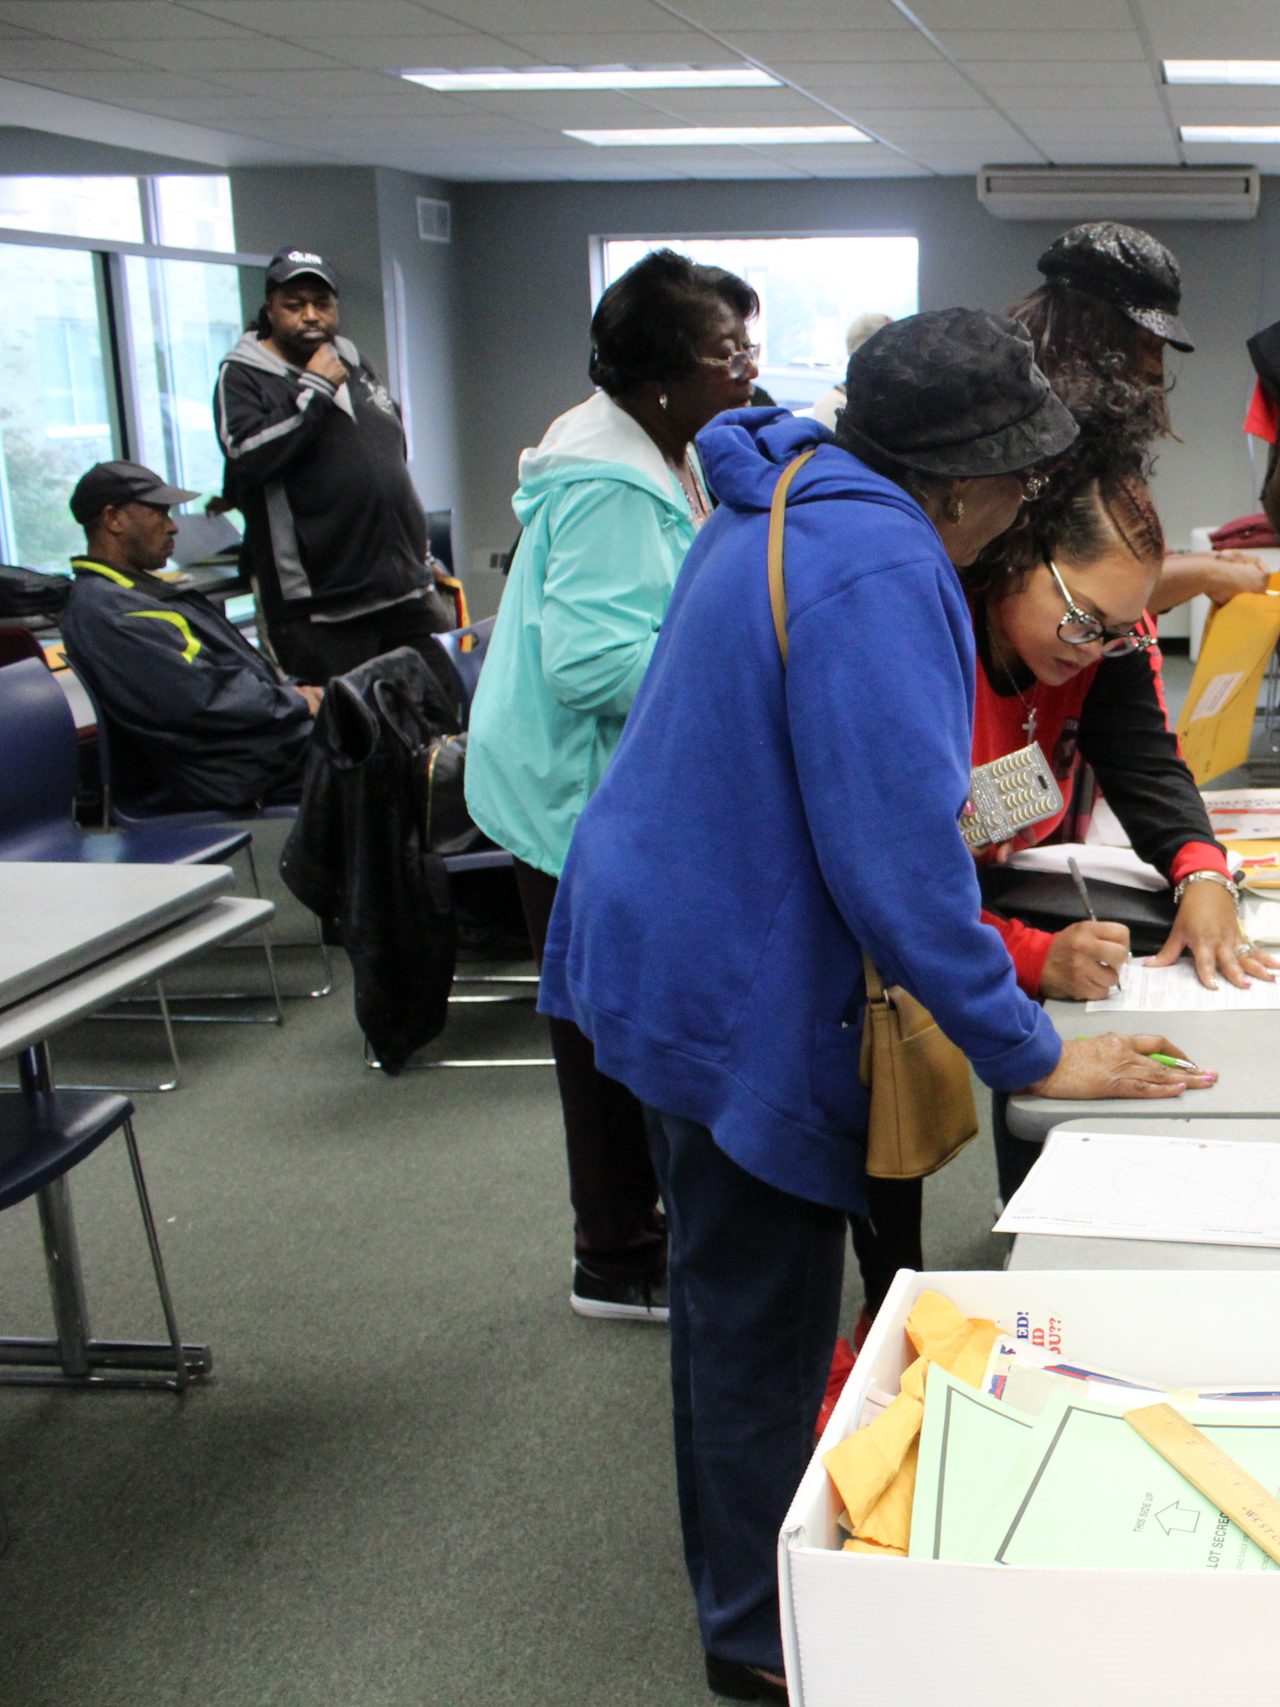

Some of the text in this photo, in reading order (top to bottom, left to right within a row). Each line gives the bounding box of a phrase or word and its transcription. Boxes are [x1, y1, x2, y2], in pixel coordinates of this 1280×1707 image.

[1016, 1311, 1029, 1339] ED!
[1031, 1327, 1045, 1347] ID
[1048, 1317, 1061, 1355] OU??
[1133, 1491, 1155, 1533] THIS SIDE UP
[1205, 1510, 1230, 1570] LOT SECREC
